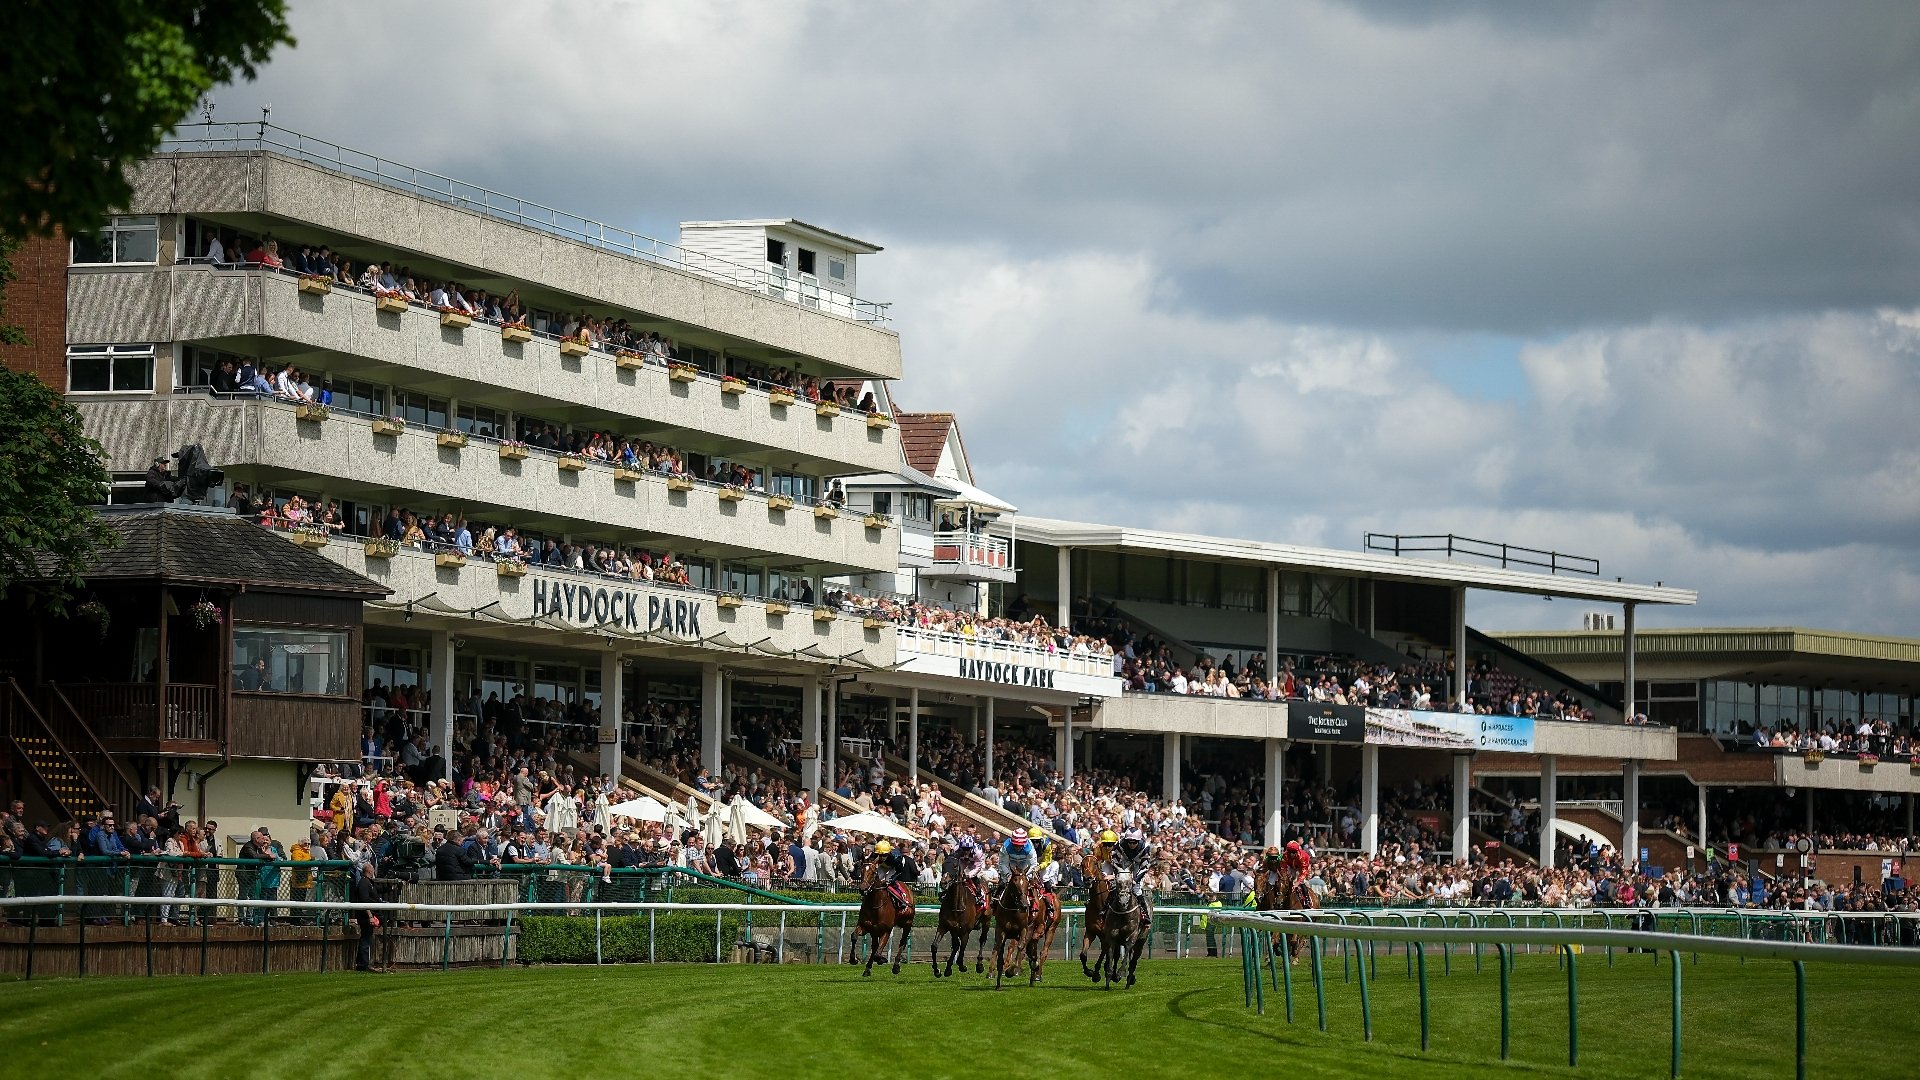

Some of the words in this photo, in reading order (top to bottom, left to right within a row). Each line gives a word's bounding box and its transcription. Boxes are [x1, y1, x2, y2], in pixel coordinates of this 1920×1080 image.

[533, 578, 638, 630] HAYDOCK
[649, 595, 701, 638] PARK
[959, 658, 1019, 684] HAYDOCK
[1024, 666, 1055, 688] PARK
